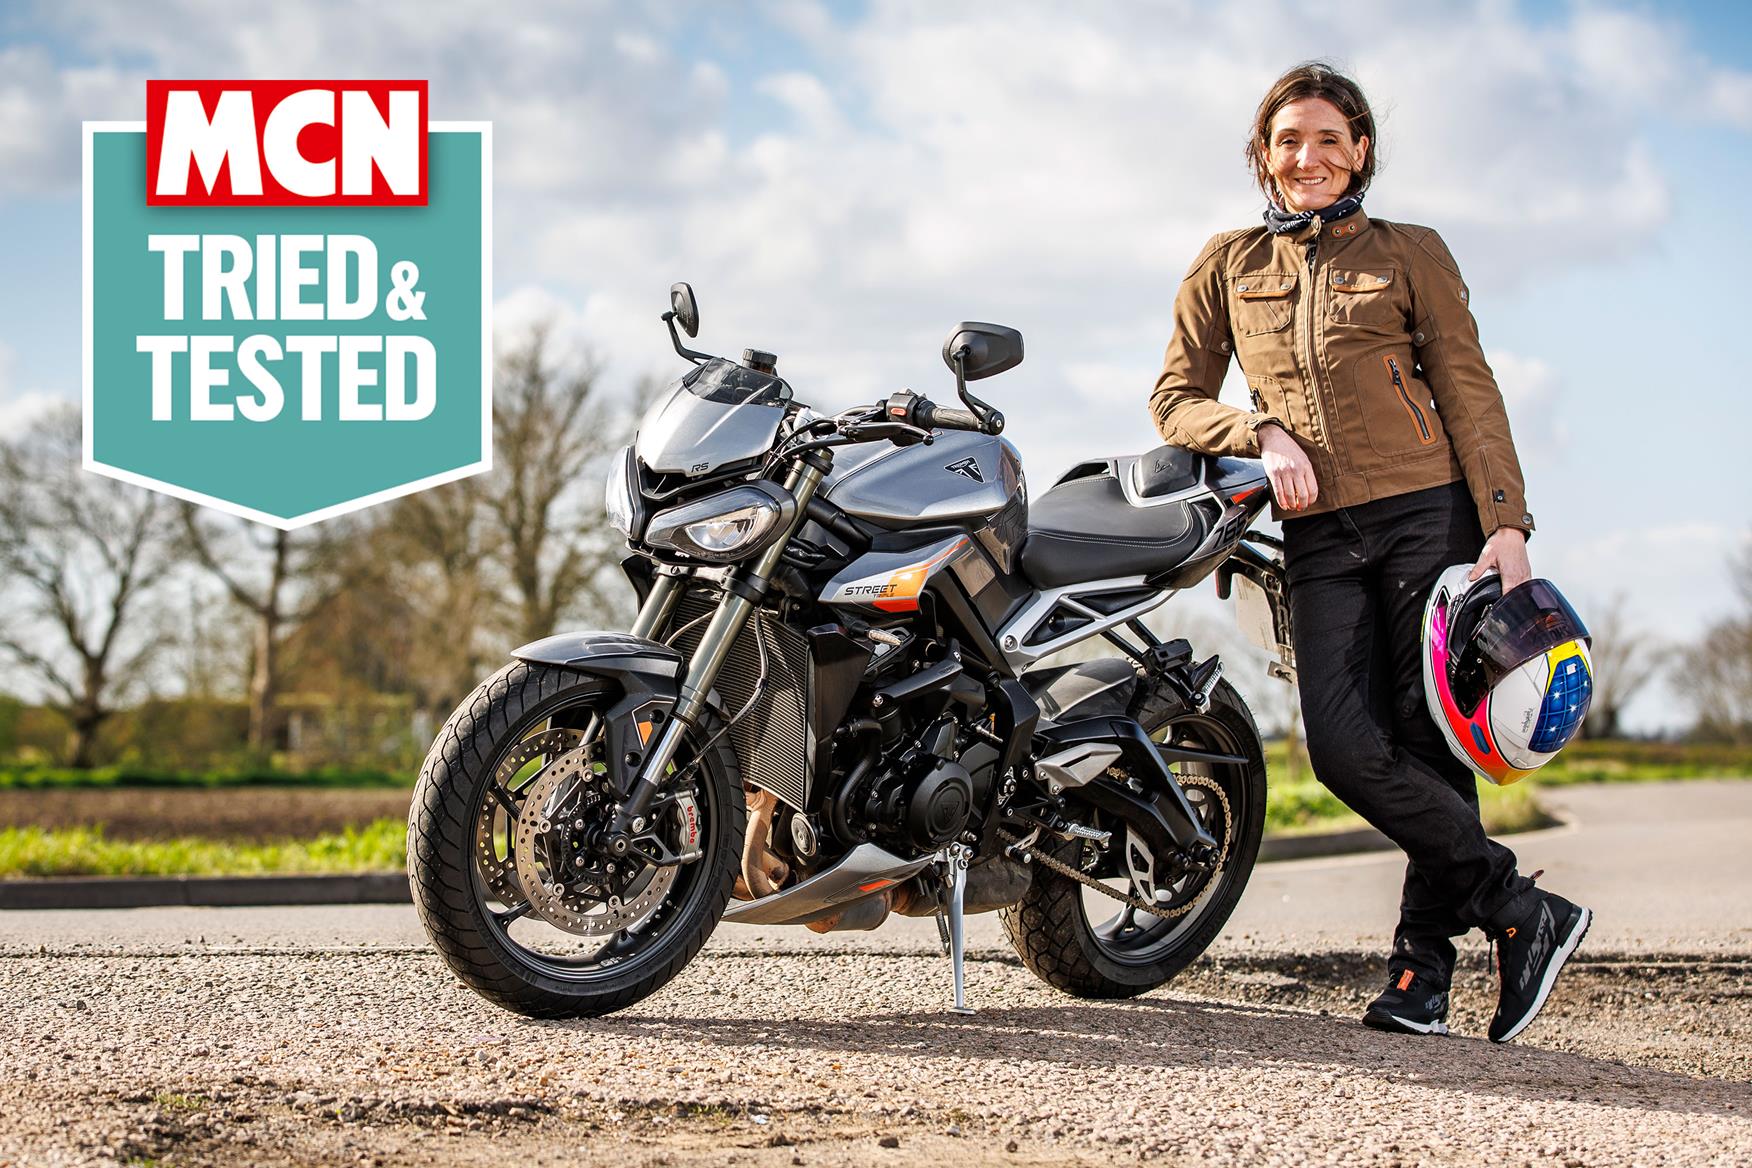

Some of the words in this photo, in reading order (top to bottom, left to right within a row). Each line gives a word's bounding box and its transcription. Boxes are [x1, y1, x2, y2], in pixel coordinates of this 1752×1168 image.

[691, 461, 709, 473] RS
[844, 584, 897, 596] STREET
[687, 805, 697, 844] brembo
